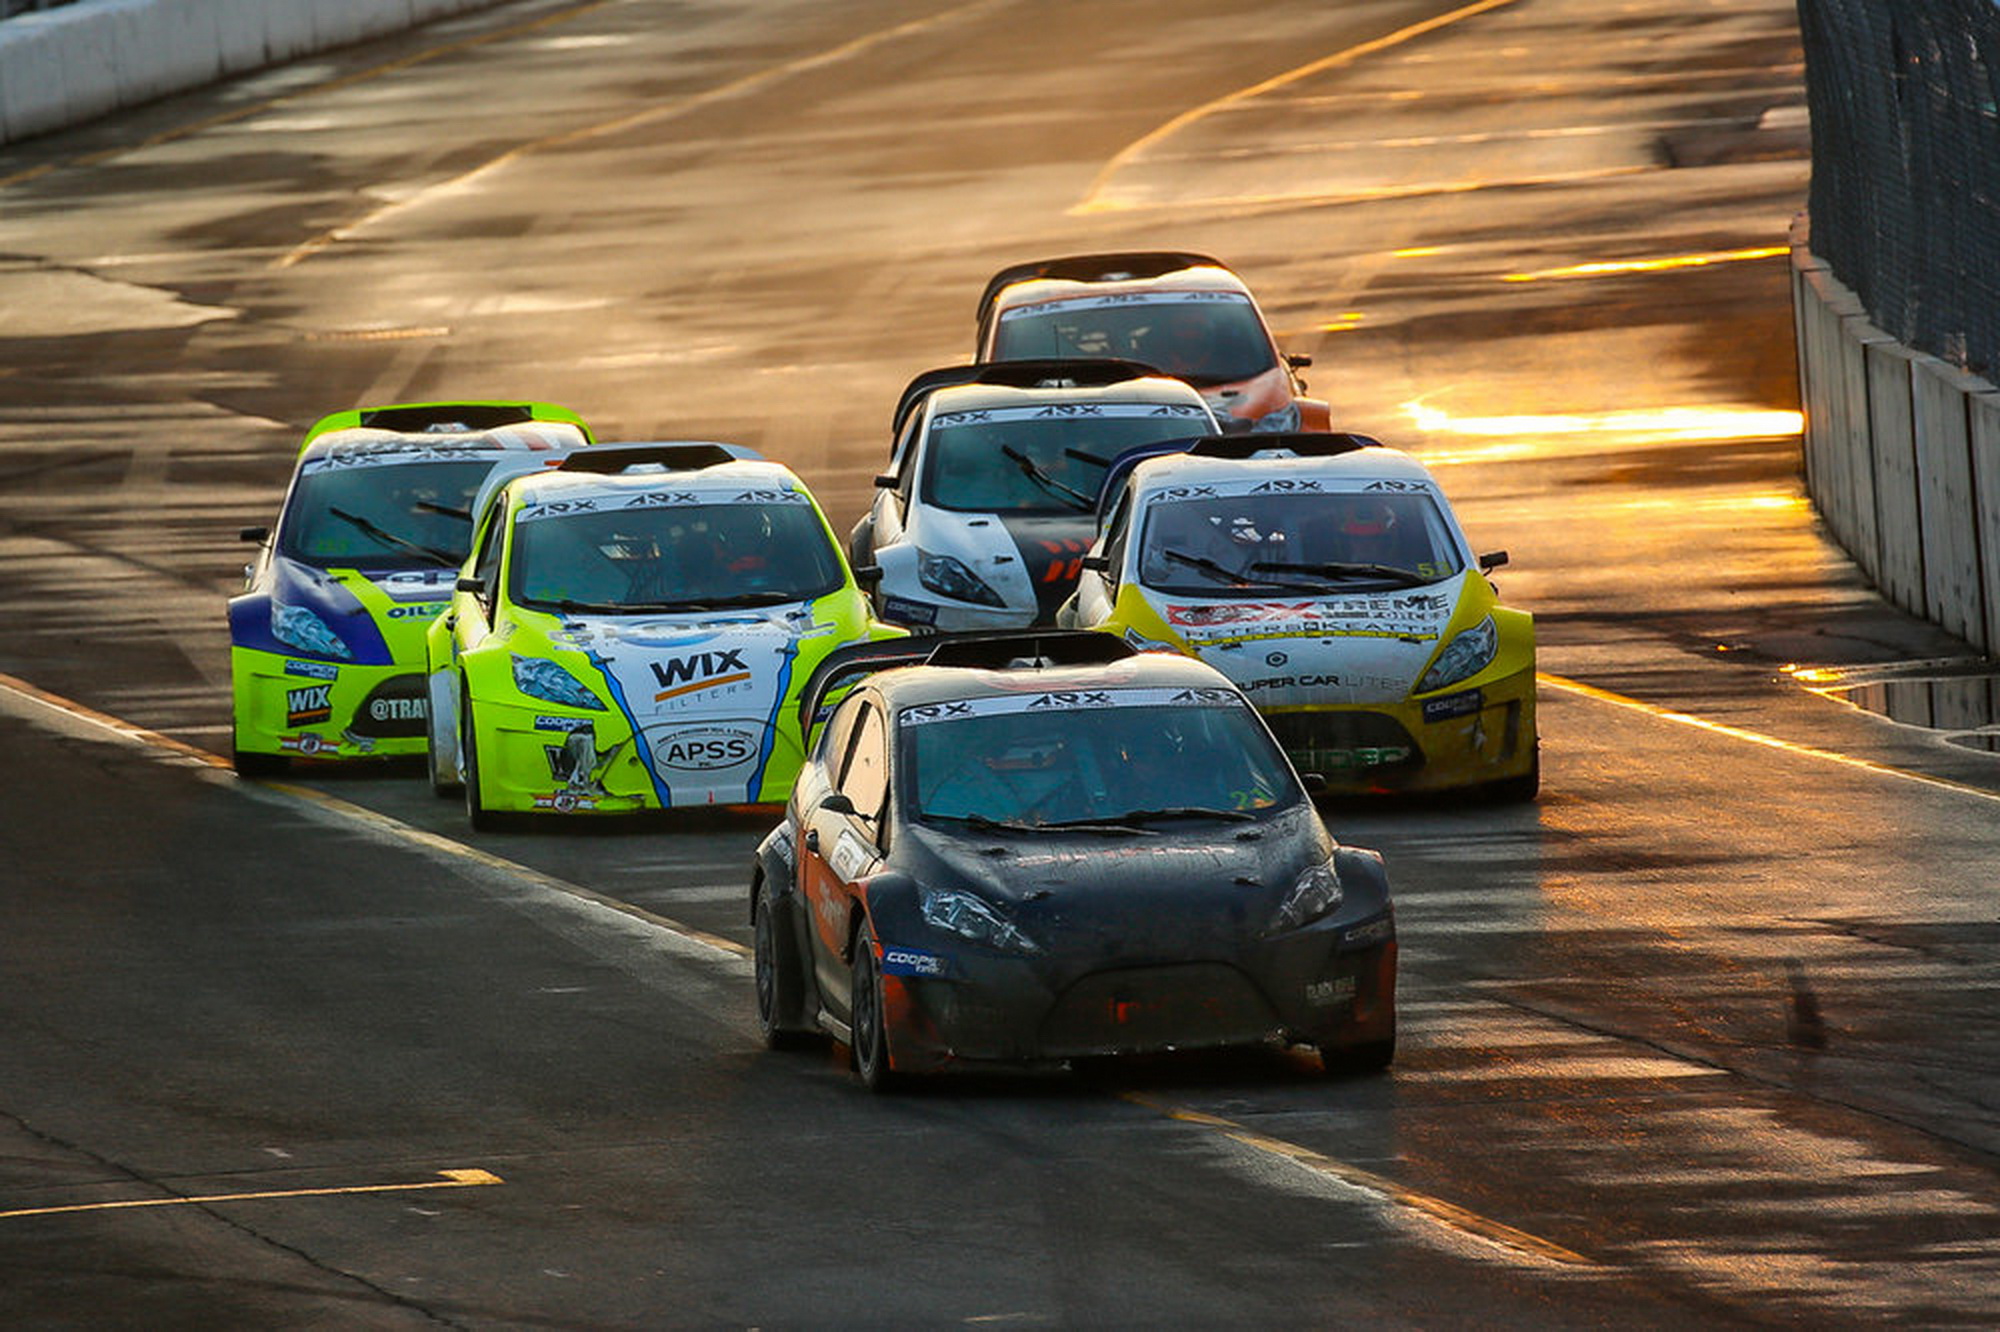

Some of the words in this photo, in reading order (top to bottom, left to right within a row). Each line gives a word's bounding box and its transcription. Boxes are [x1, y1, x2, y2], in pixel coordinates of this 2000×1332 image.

[1251, 479, 1325, 493] ARX
[625, 492, 698, 506] ARX
[650, 648, 748, 688] WIX
[1300, 674, 1340, 687] CAR
[289, 686, 330, 712] WIX
[655, 683, 753, 713] FILTERS
[668, 740, 746, 762] APSS
